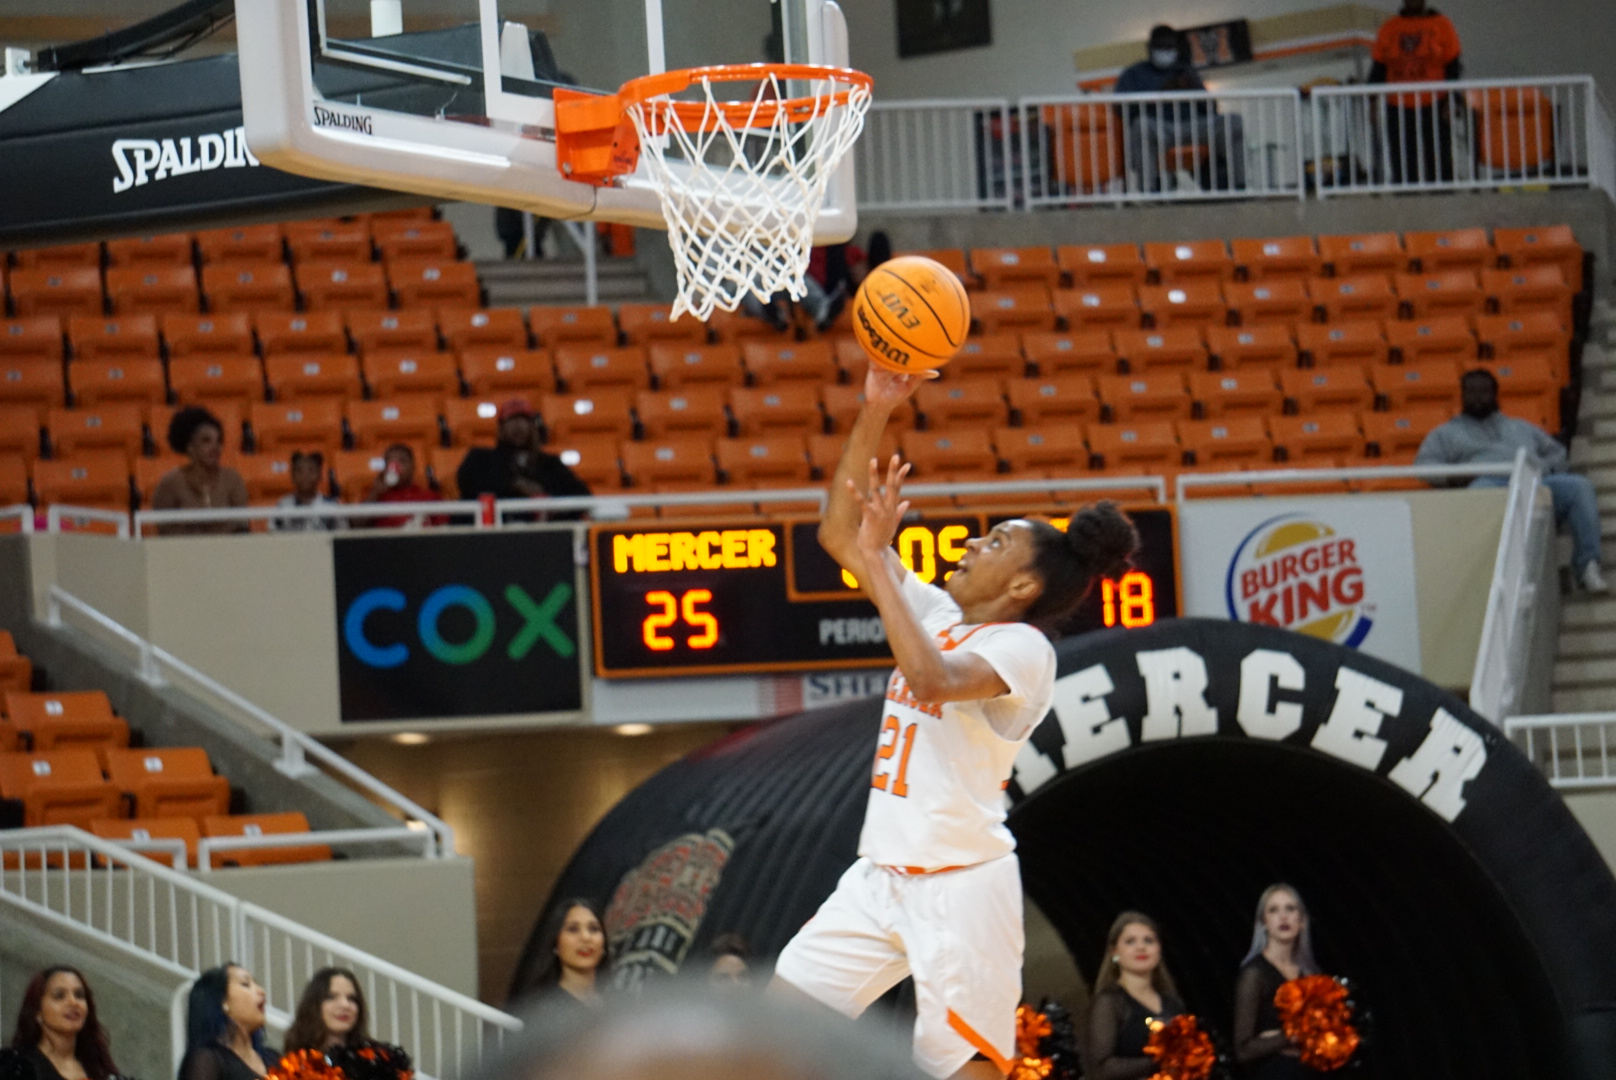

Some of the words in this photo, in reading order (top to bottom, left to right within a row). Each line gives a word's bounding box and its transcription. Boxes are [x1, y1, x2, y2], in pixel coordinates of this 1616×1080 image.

[313, 106, 373, 135] SPALDING
[112, 126, 260, 193] SPALDIN
[613, 529, 777, 573] MERCER
[1241, 538, 1357, 600] BURGER
[344, 582, 575, 668] COX
[643, 589, 719, 650] 25
[1101, 571, 1155, 629] 18
[1248, 566, 1365, 628] KING
[819, 616, 888, 645] PERIO
[871, 714, 918, 798] 21
